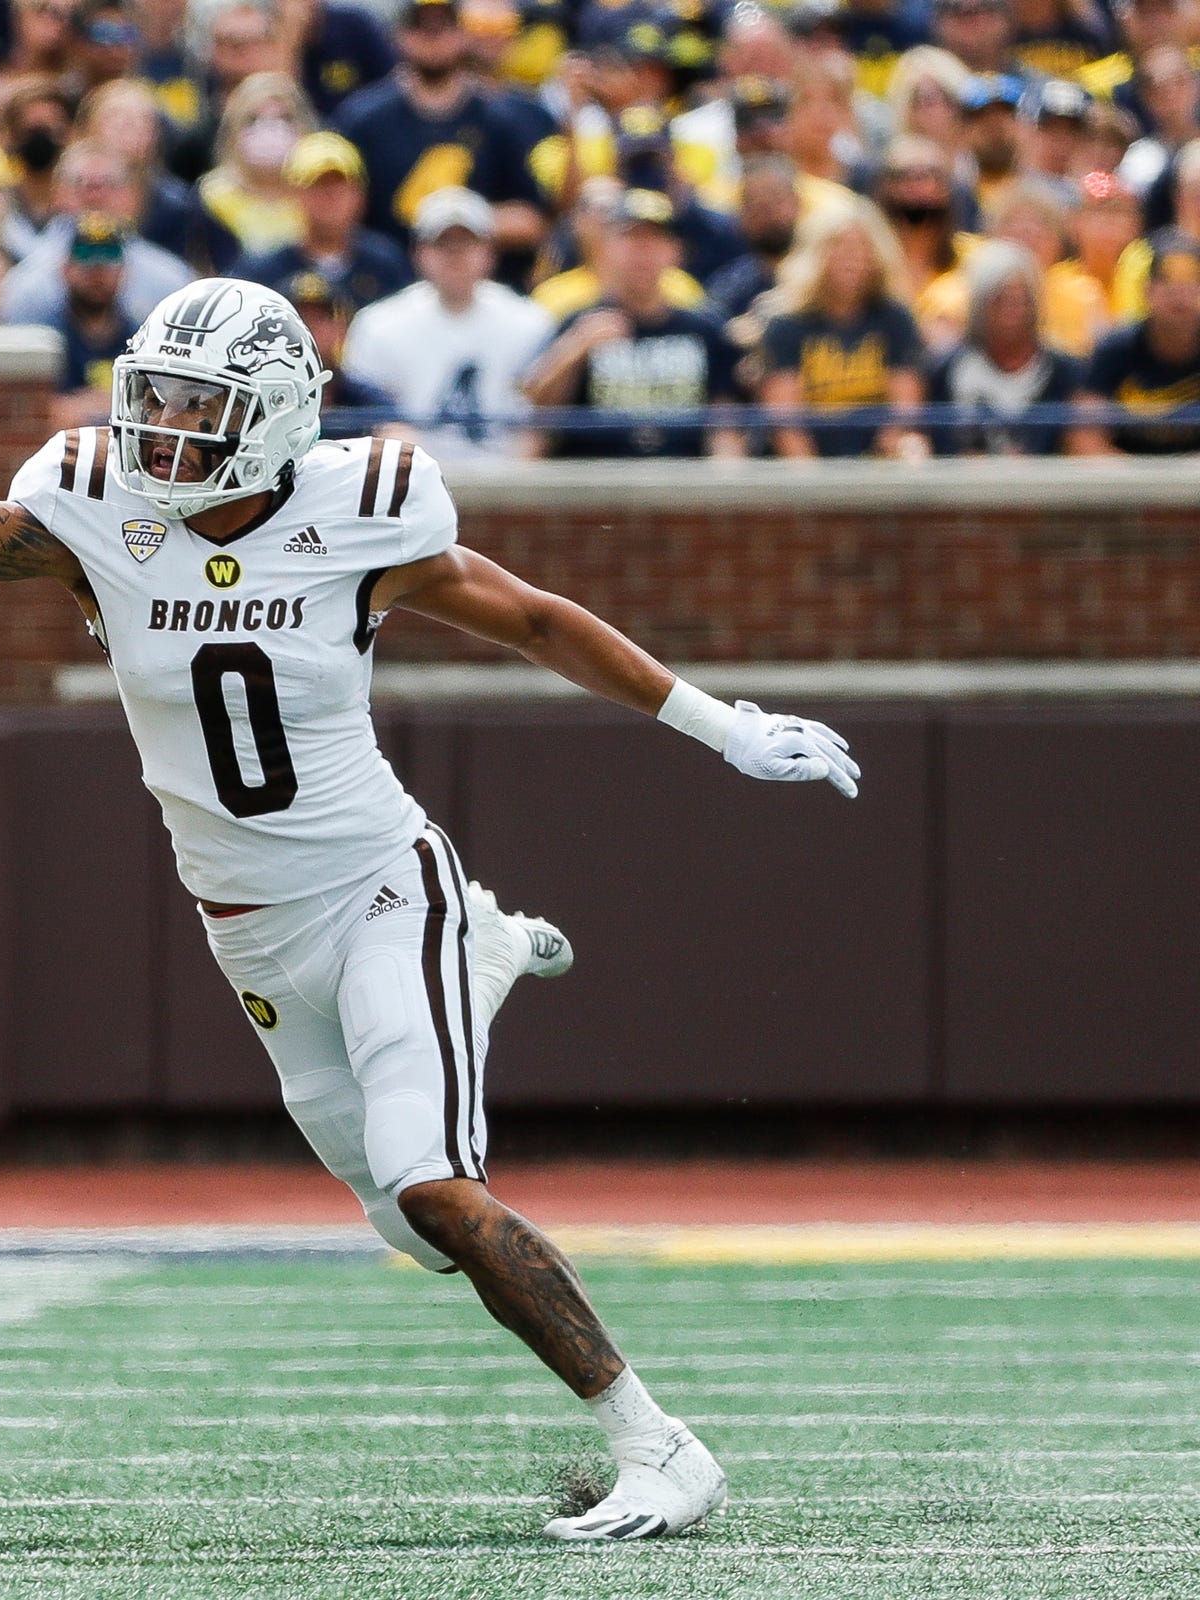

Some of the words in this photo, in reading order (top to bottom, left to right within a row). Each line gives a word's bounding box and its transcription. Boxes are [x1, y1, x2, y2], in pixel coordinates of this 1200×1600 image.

[159, 345, 192, 359] FOUR
[125, 531, 163, 546] MAC
[283, 543, 328, 555] adidas
[209, 561, 235, 584] W
[147, 596, 307, 632] BRONCOS
[190, 641, 299, 819] 0
[365, 898, 409, 921] adidas
[244, 999, 272, 1024] W
